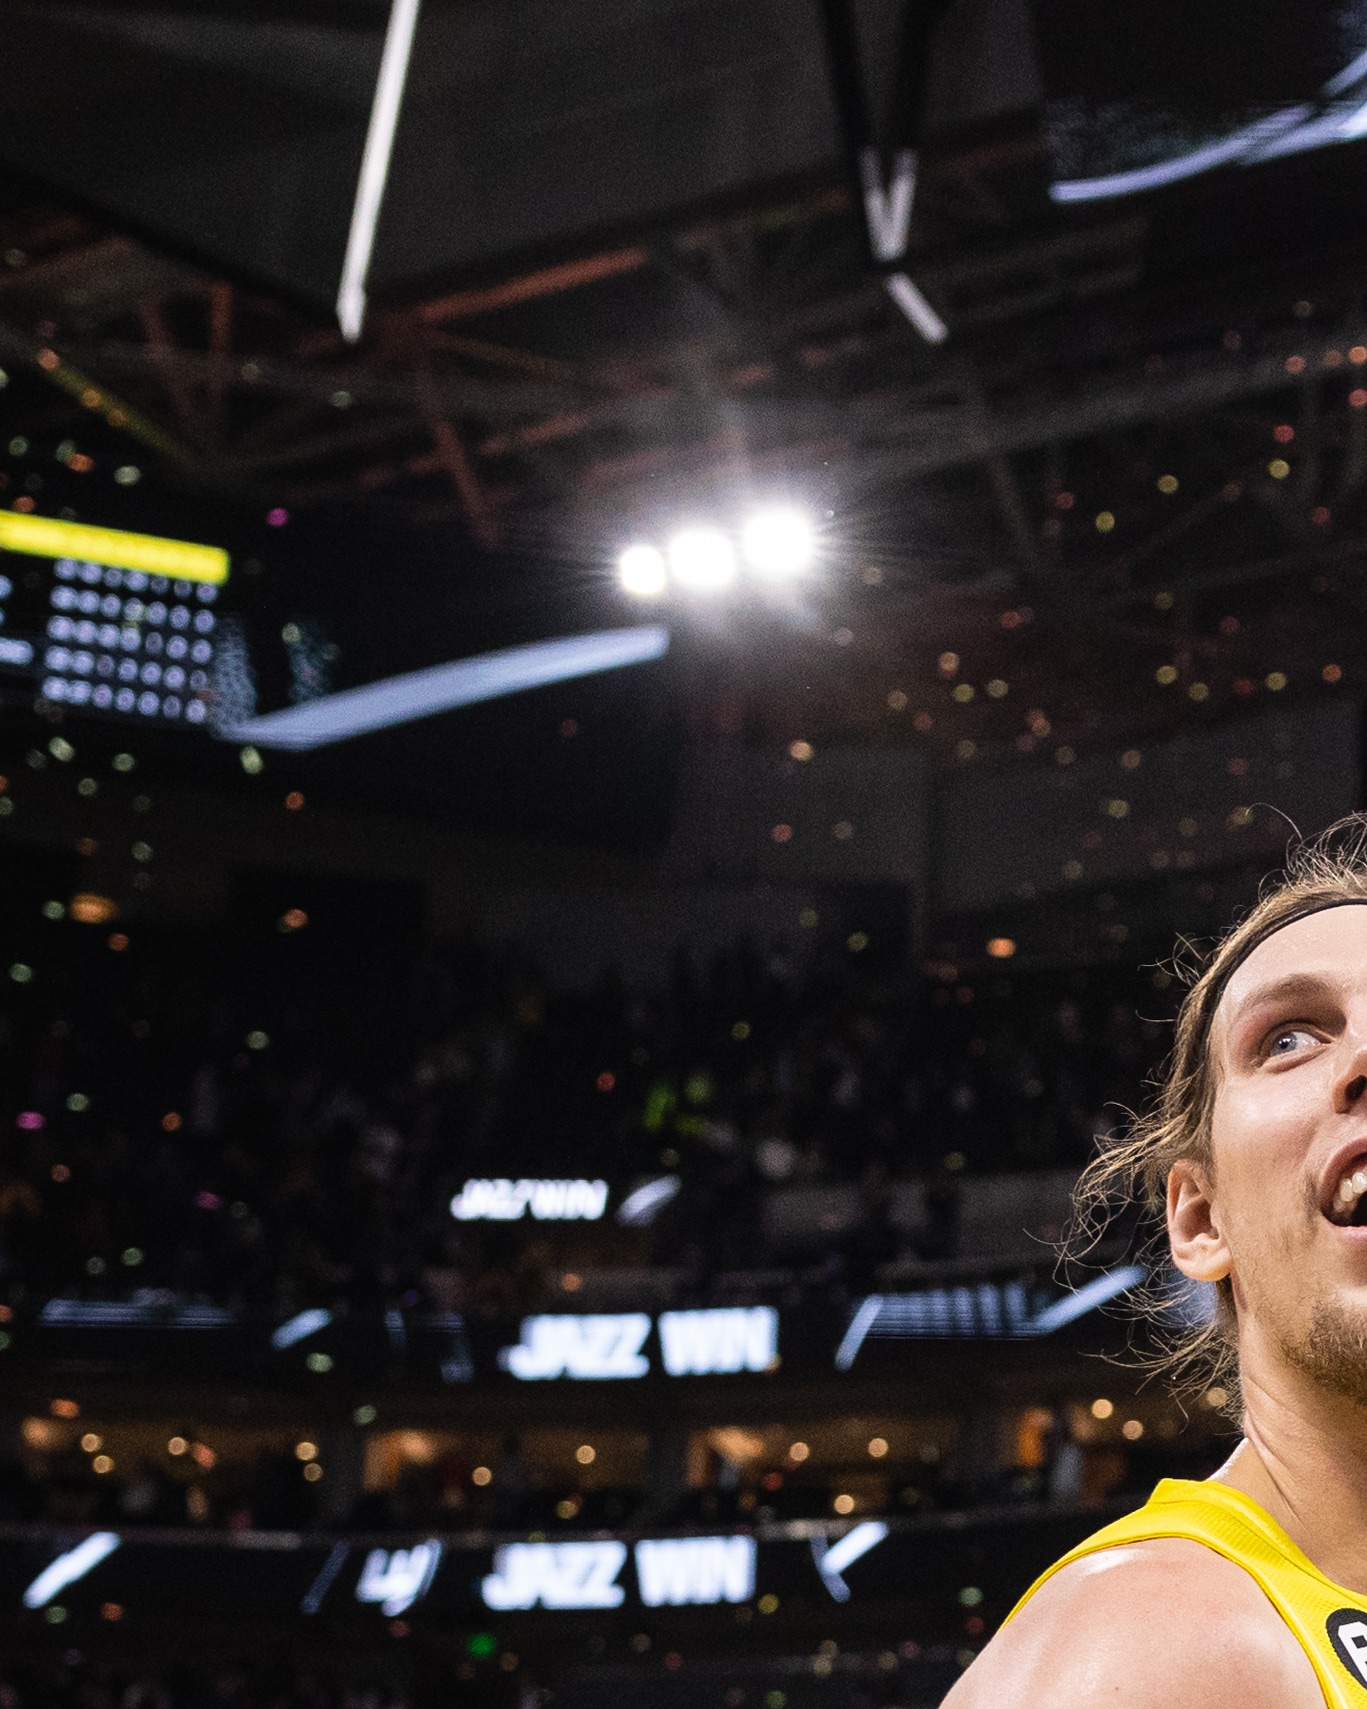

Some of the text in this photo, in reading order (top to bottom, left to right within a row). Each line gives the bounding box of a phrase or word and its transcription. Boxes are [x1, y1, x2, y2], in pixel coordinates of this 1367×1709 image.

[505, 1307, 777, 1379] JAZZ WIN
[483, 1536, 755, 1610] JAZZ WIN
